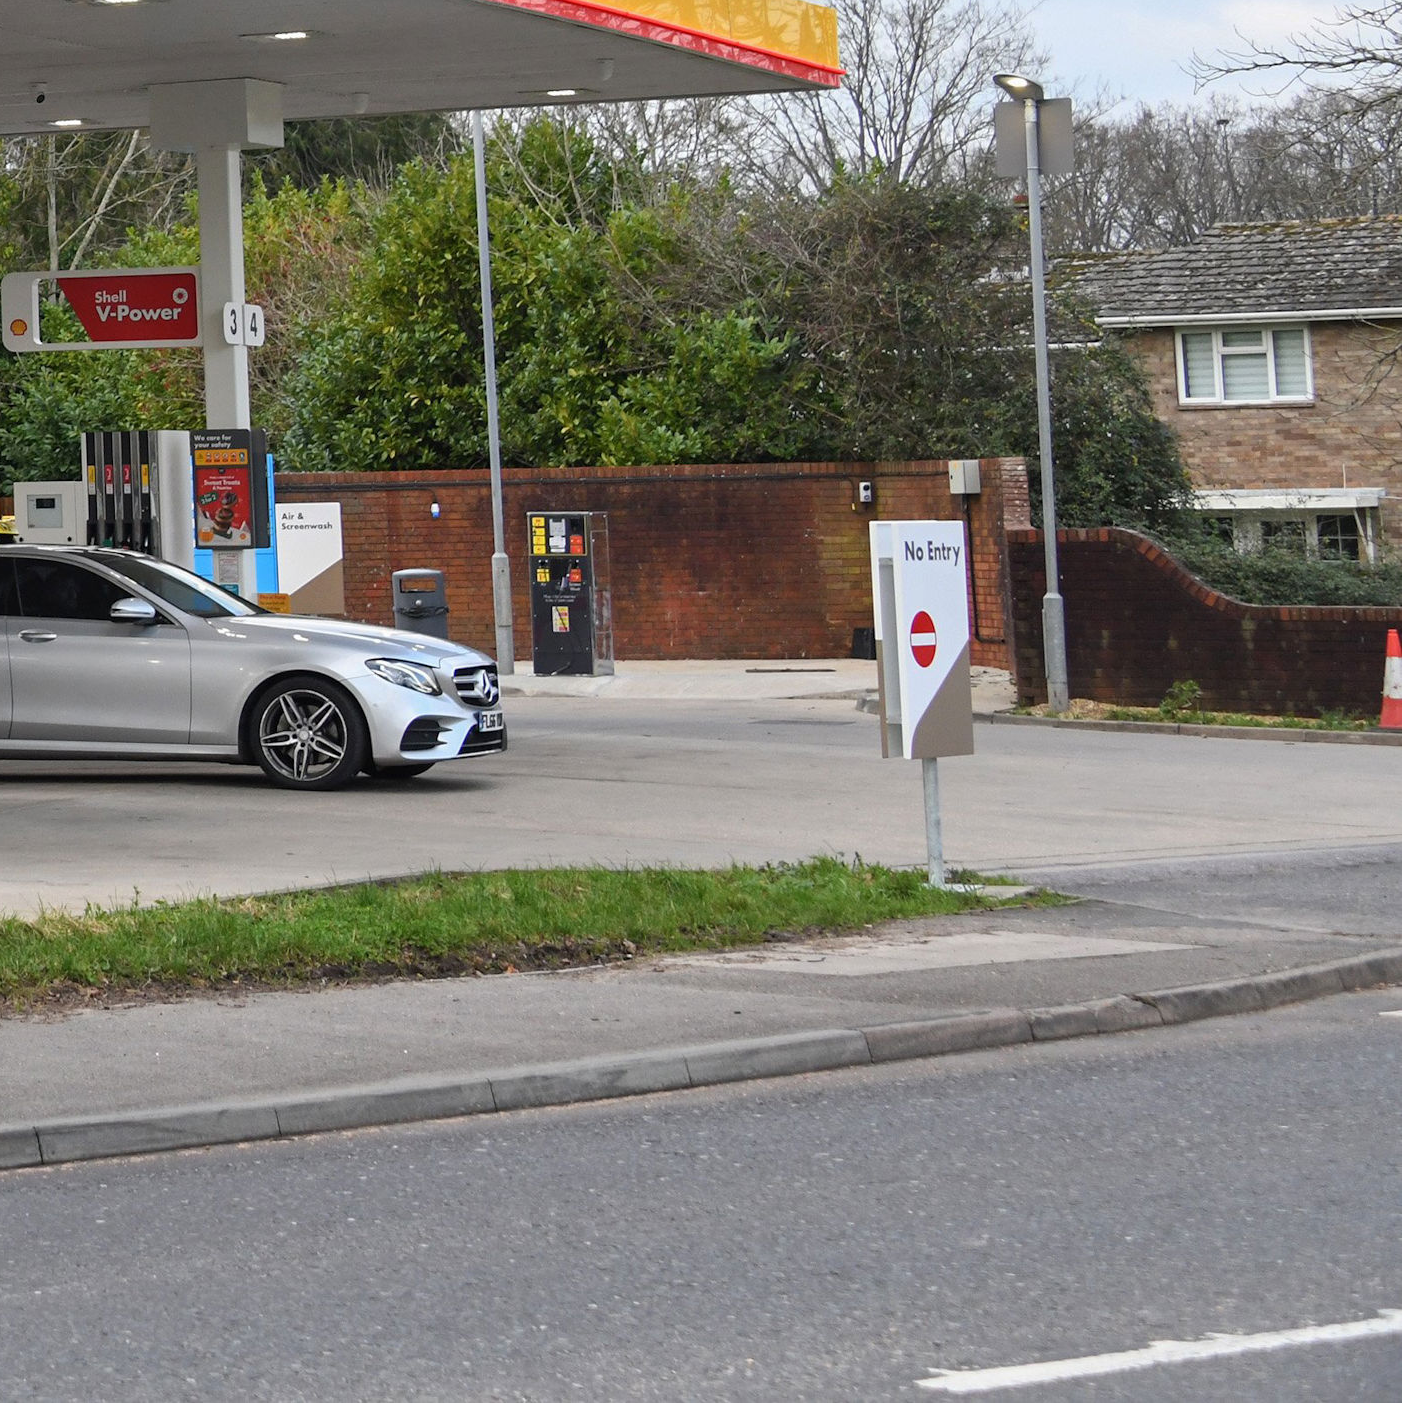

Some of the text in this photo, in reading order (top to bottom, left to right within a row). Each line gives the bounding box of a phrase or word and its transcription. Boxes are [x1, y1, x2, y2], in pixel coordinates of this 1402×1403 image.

[95, 290, 126, 303] Shell
[96, 305, 182, 322] V-Power
[230, 309, 237, 335] 3
[250, 313, 258, 337] 4
[282, 512, 304, 520] Air &
[281, 522, 333, 530] Screenwash
[904, 541, 960, 567] No Entry
